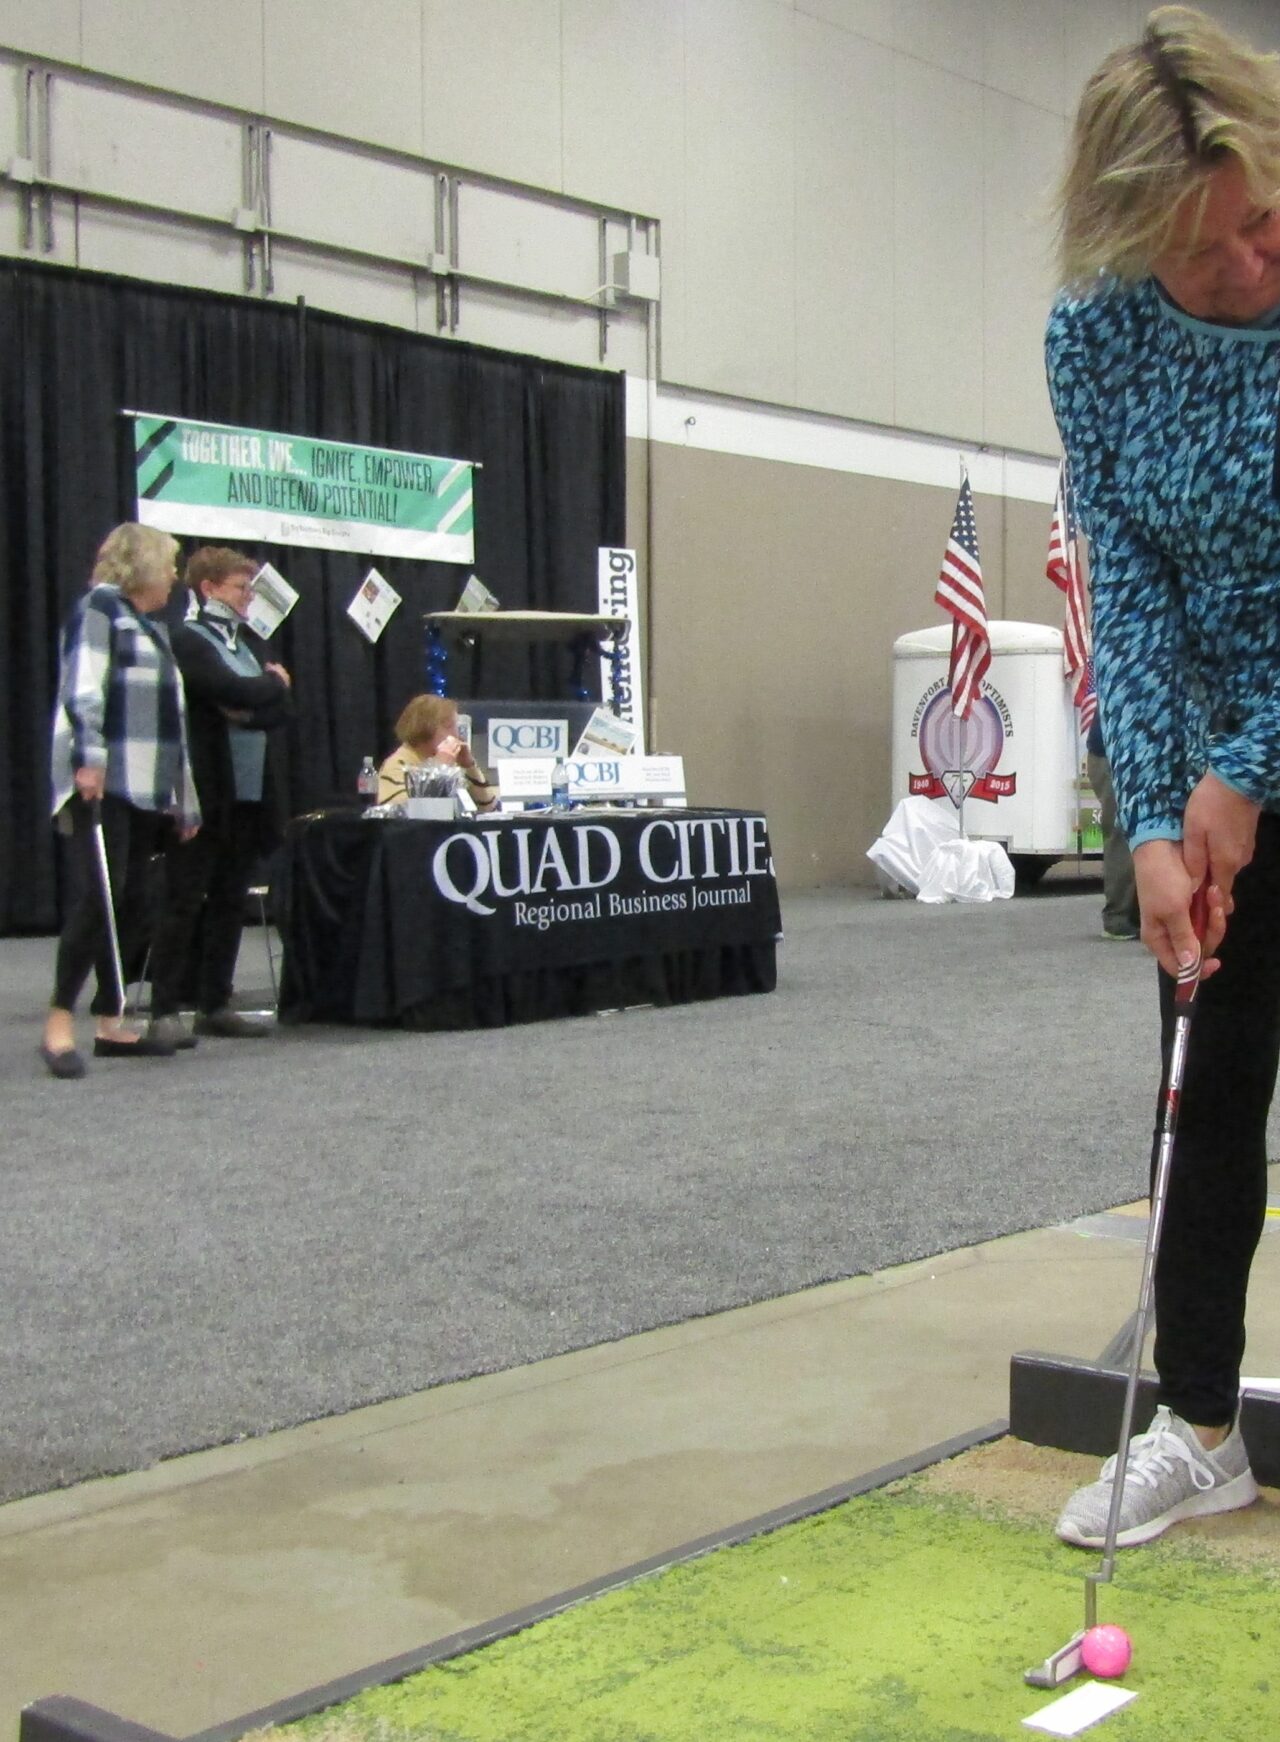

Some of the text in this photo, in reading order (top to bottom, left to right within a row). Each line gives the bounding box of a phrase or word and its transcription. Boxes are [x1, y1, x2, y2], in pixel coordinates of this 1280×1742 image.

[227, 471, 398, 523] AND DEFEND POTENTIAL!
[910, 677, 946, 738] DAVENPORT
[492, 724, 562, 753] QCBJ
[565, 761, 621, 787] QCBJ
[432, 817, 777, 916] QUAD CITIE
[514, 880, 752, 931] Regional Business Journal
